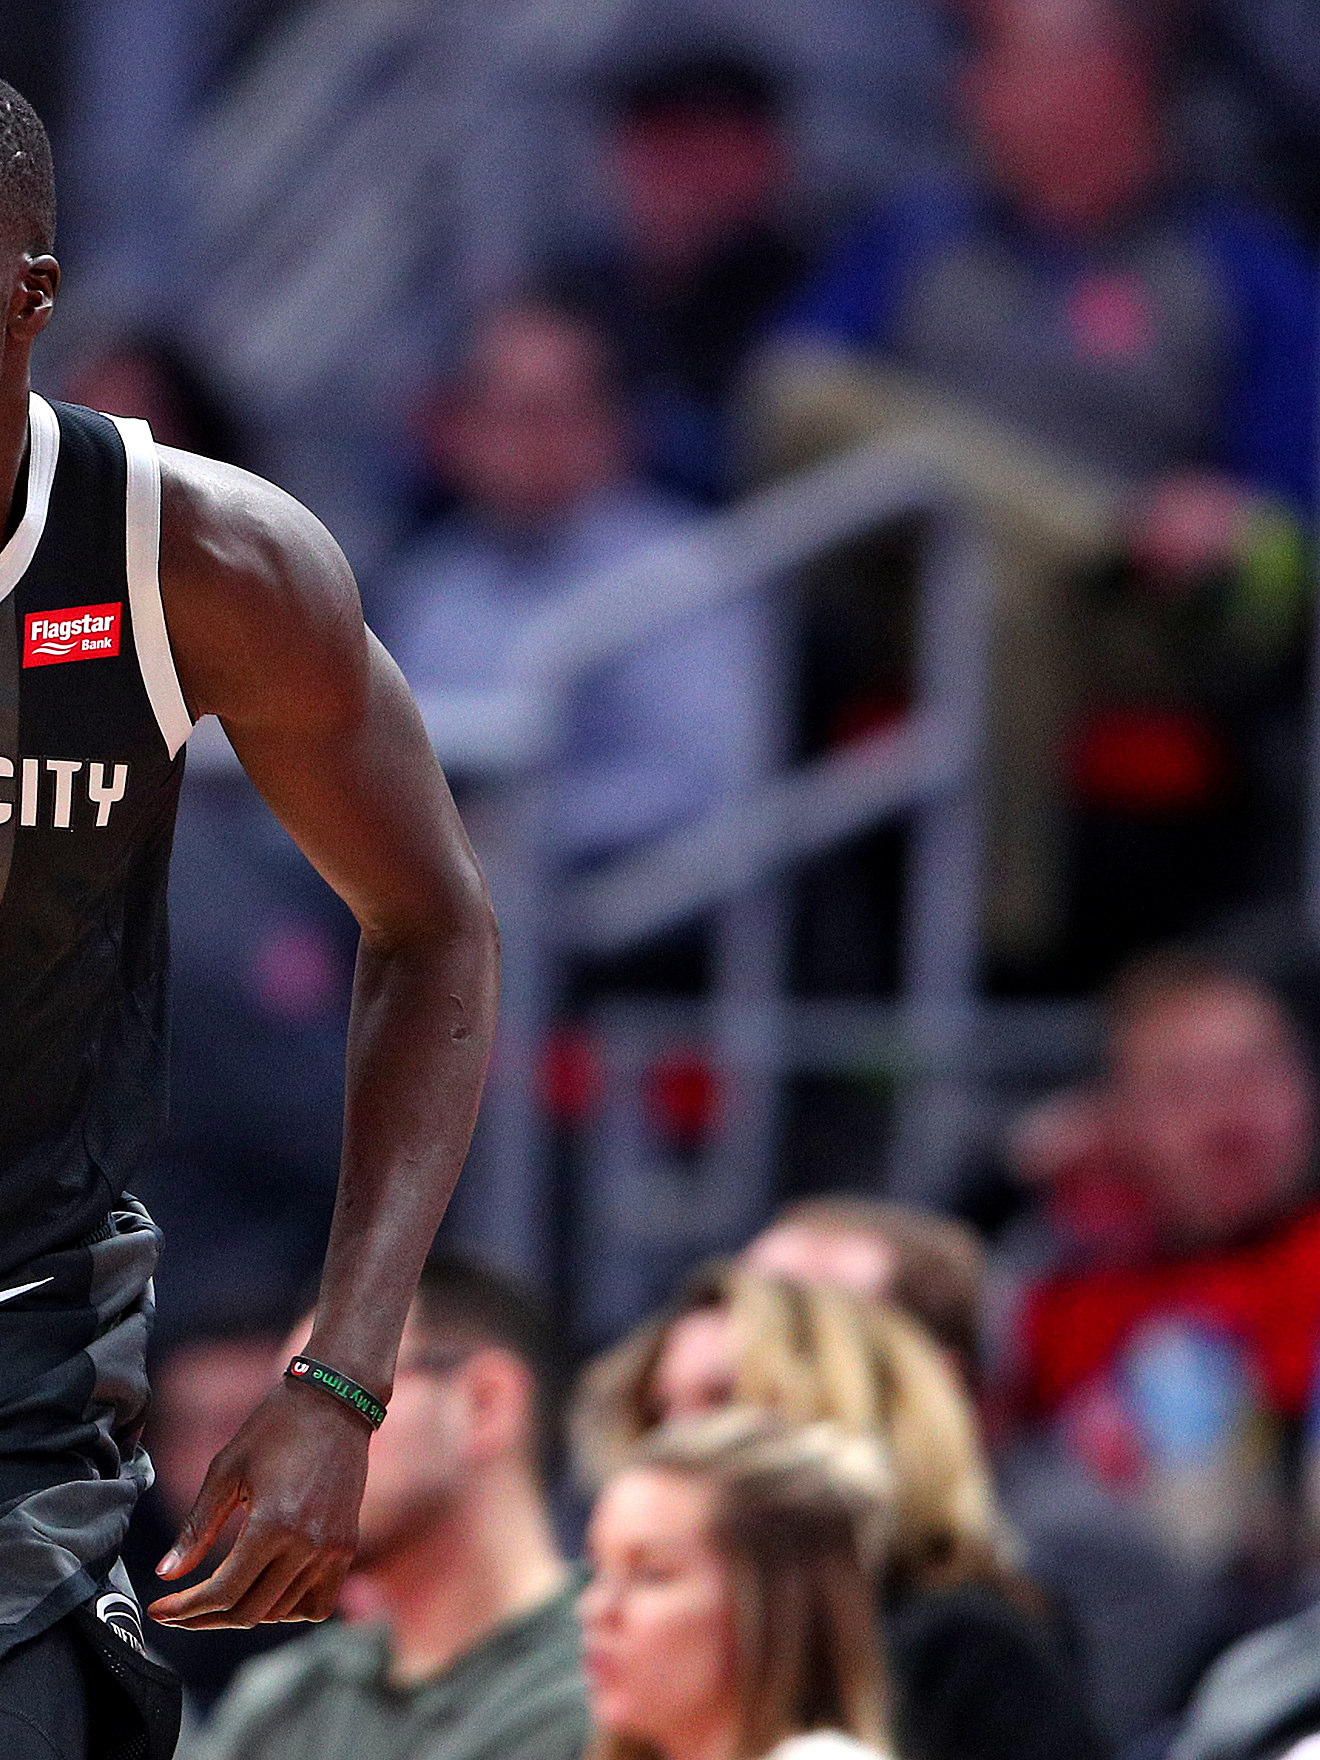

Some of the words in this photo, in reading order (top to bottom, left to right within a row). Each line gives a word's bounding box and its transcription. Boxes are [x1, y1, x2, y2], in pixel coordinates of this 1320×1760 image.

[31, 614, 114, 641] Flagstar
[81, 637, 112, 651] Bank
[313, 1368, 349, 1398] Time
[349, 1389, 371, 1412] My
